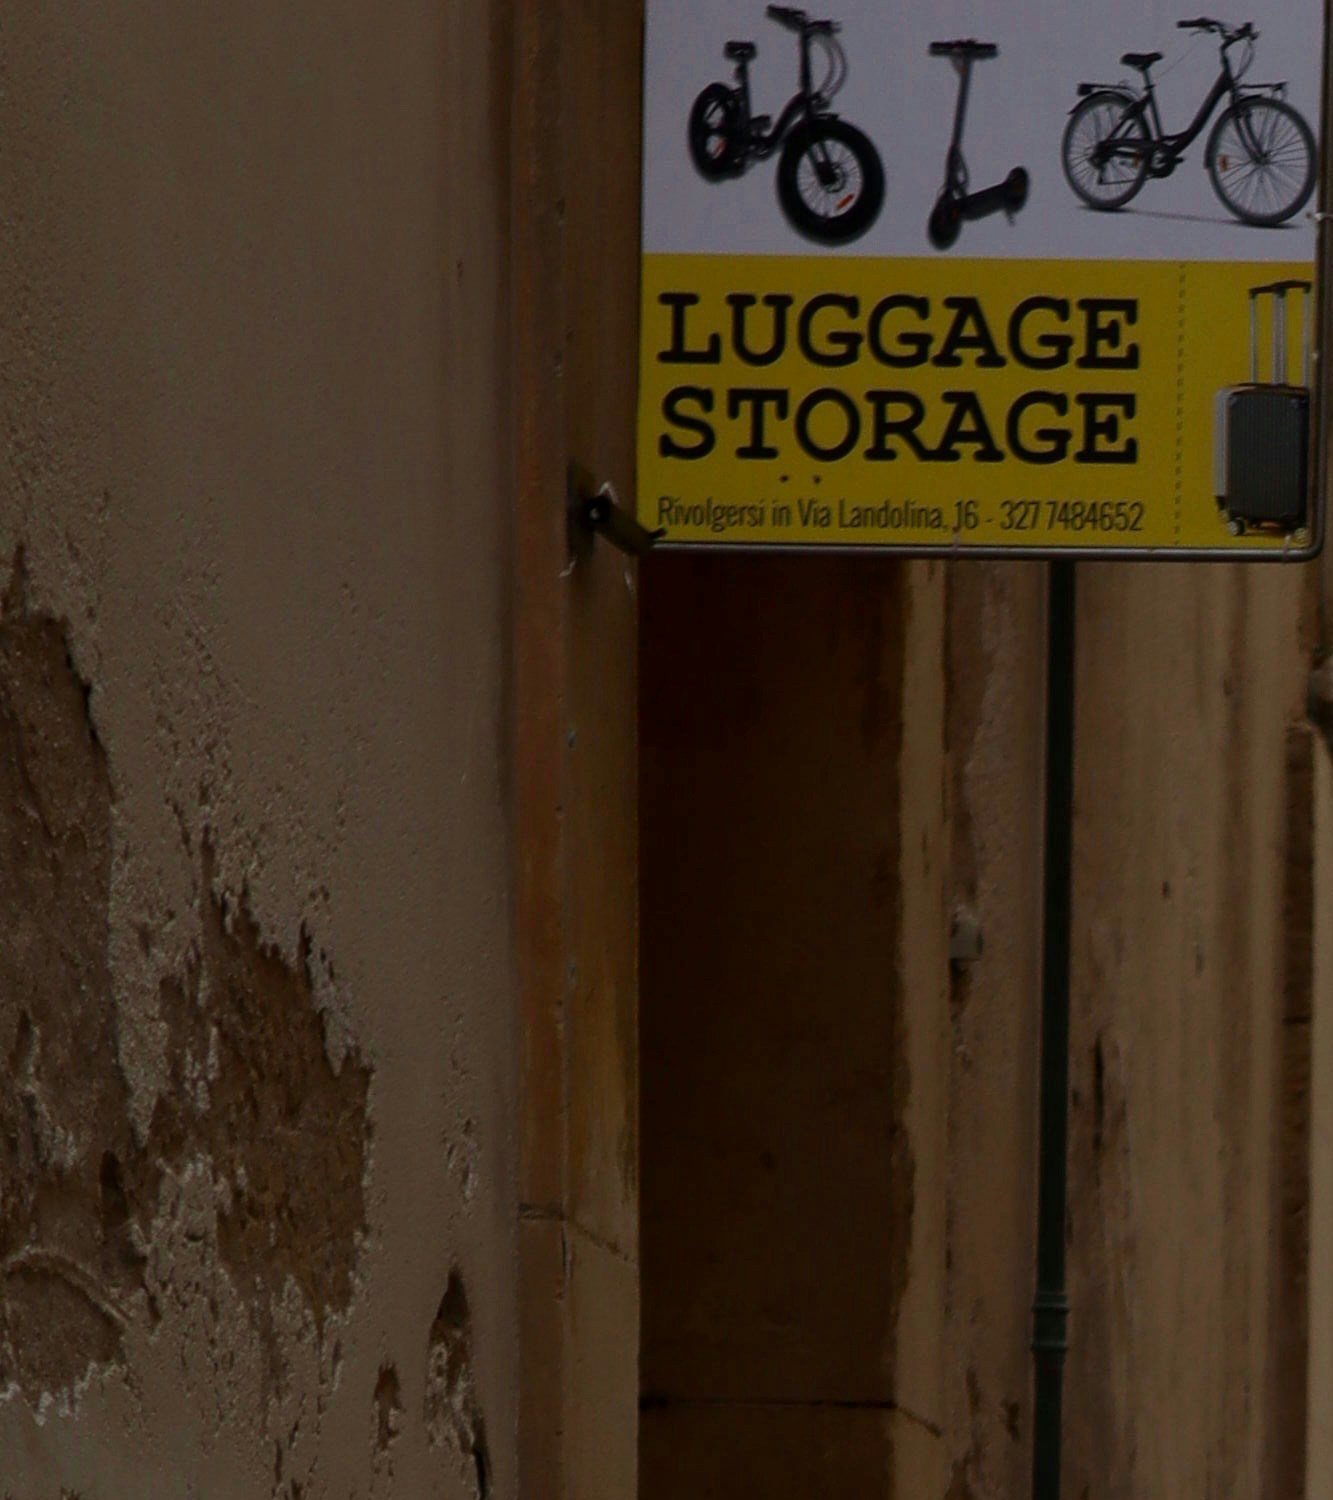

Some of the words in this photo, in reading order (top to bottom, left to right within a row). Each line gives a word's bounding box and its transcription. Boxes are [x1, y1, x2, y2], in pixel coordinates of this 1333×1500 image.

[657, 293, 1140, 370] LUGGAGE
[659, 386, 1138, 464] STORAGE
[657, 496, 765, 533] Rivolgersi
[772, 500, 792, 527] in
[798, 498, 831, 527] Via
[954, 500, 979, 531] 16
